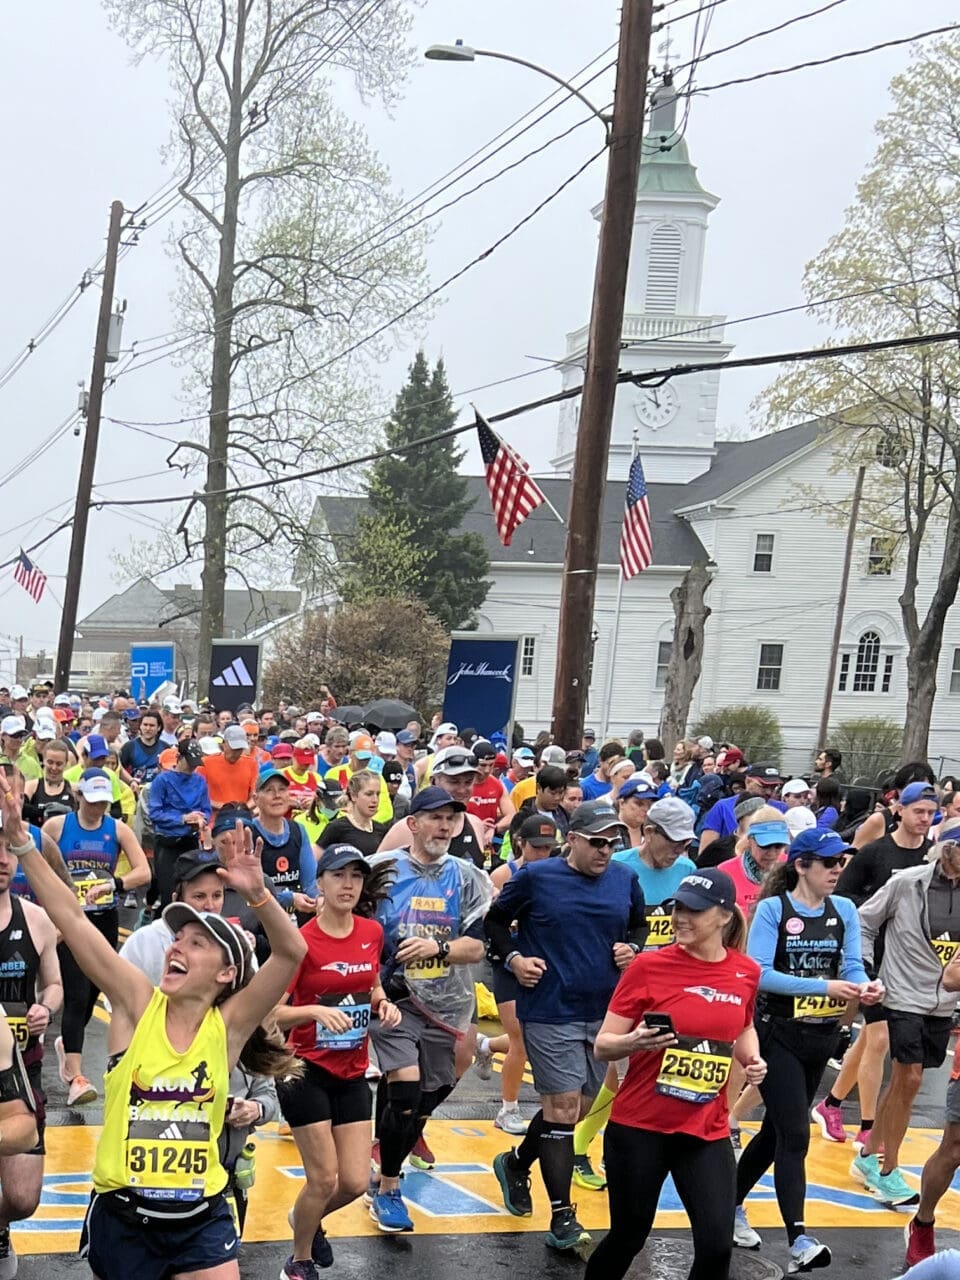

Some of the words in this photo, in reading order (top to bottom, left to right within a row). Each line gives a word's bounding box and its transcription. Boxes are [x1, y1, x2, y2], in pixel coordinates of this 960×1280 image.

[347, 963, 373, 974] TEAM
[714, 992, 742, 1006] TEAM
[662, 1054, 729, 1084] 25835
[151, 1076, 196, 1093] RUN
[130, 1146, 209, 1175] 31245
